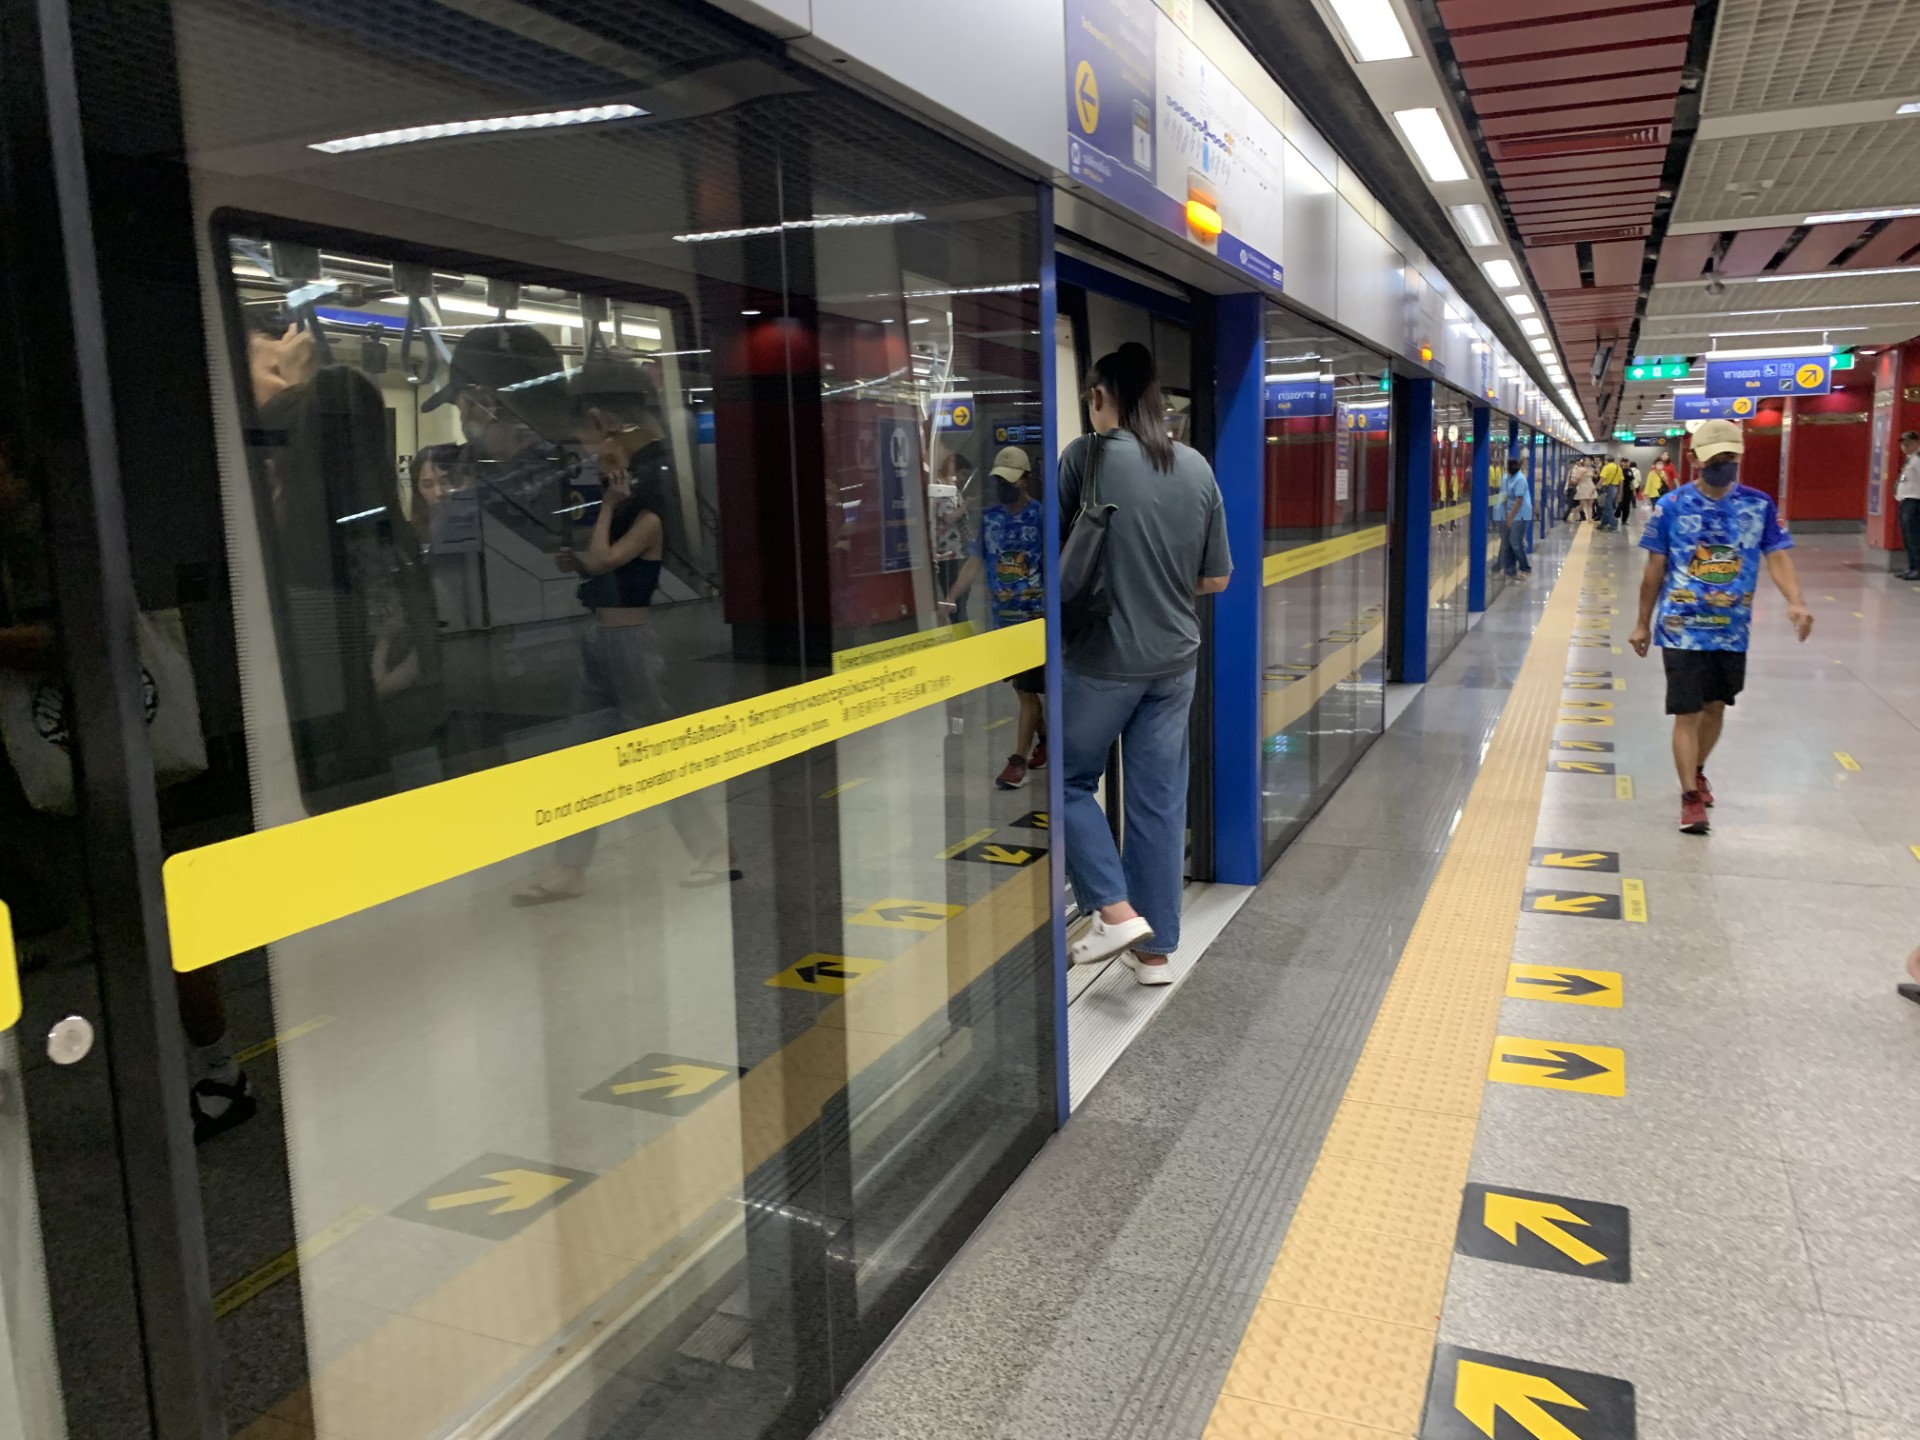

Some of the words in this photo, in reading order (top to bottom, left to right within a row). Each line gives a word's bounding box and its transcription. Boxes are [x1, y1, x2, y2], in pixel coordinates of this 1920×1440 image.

[535, 809, 552, 826] Do
[555, 803, 571, 819] not
[574, 789, 616, 812] obstruct
[617, 784, 633, 798] the
[635, 769, 677, 794] operation
[679, 761, 688, 777] of
[688, 760, 702, 774] the
